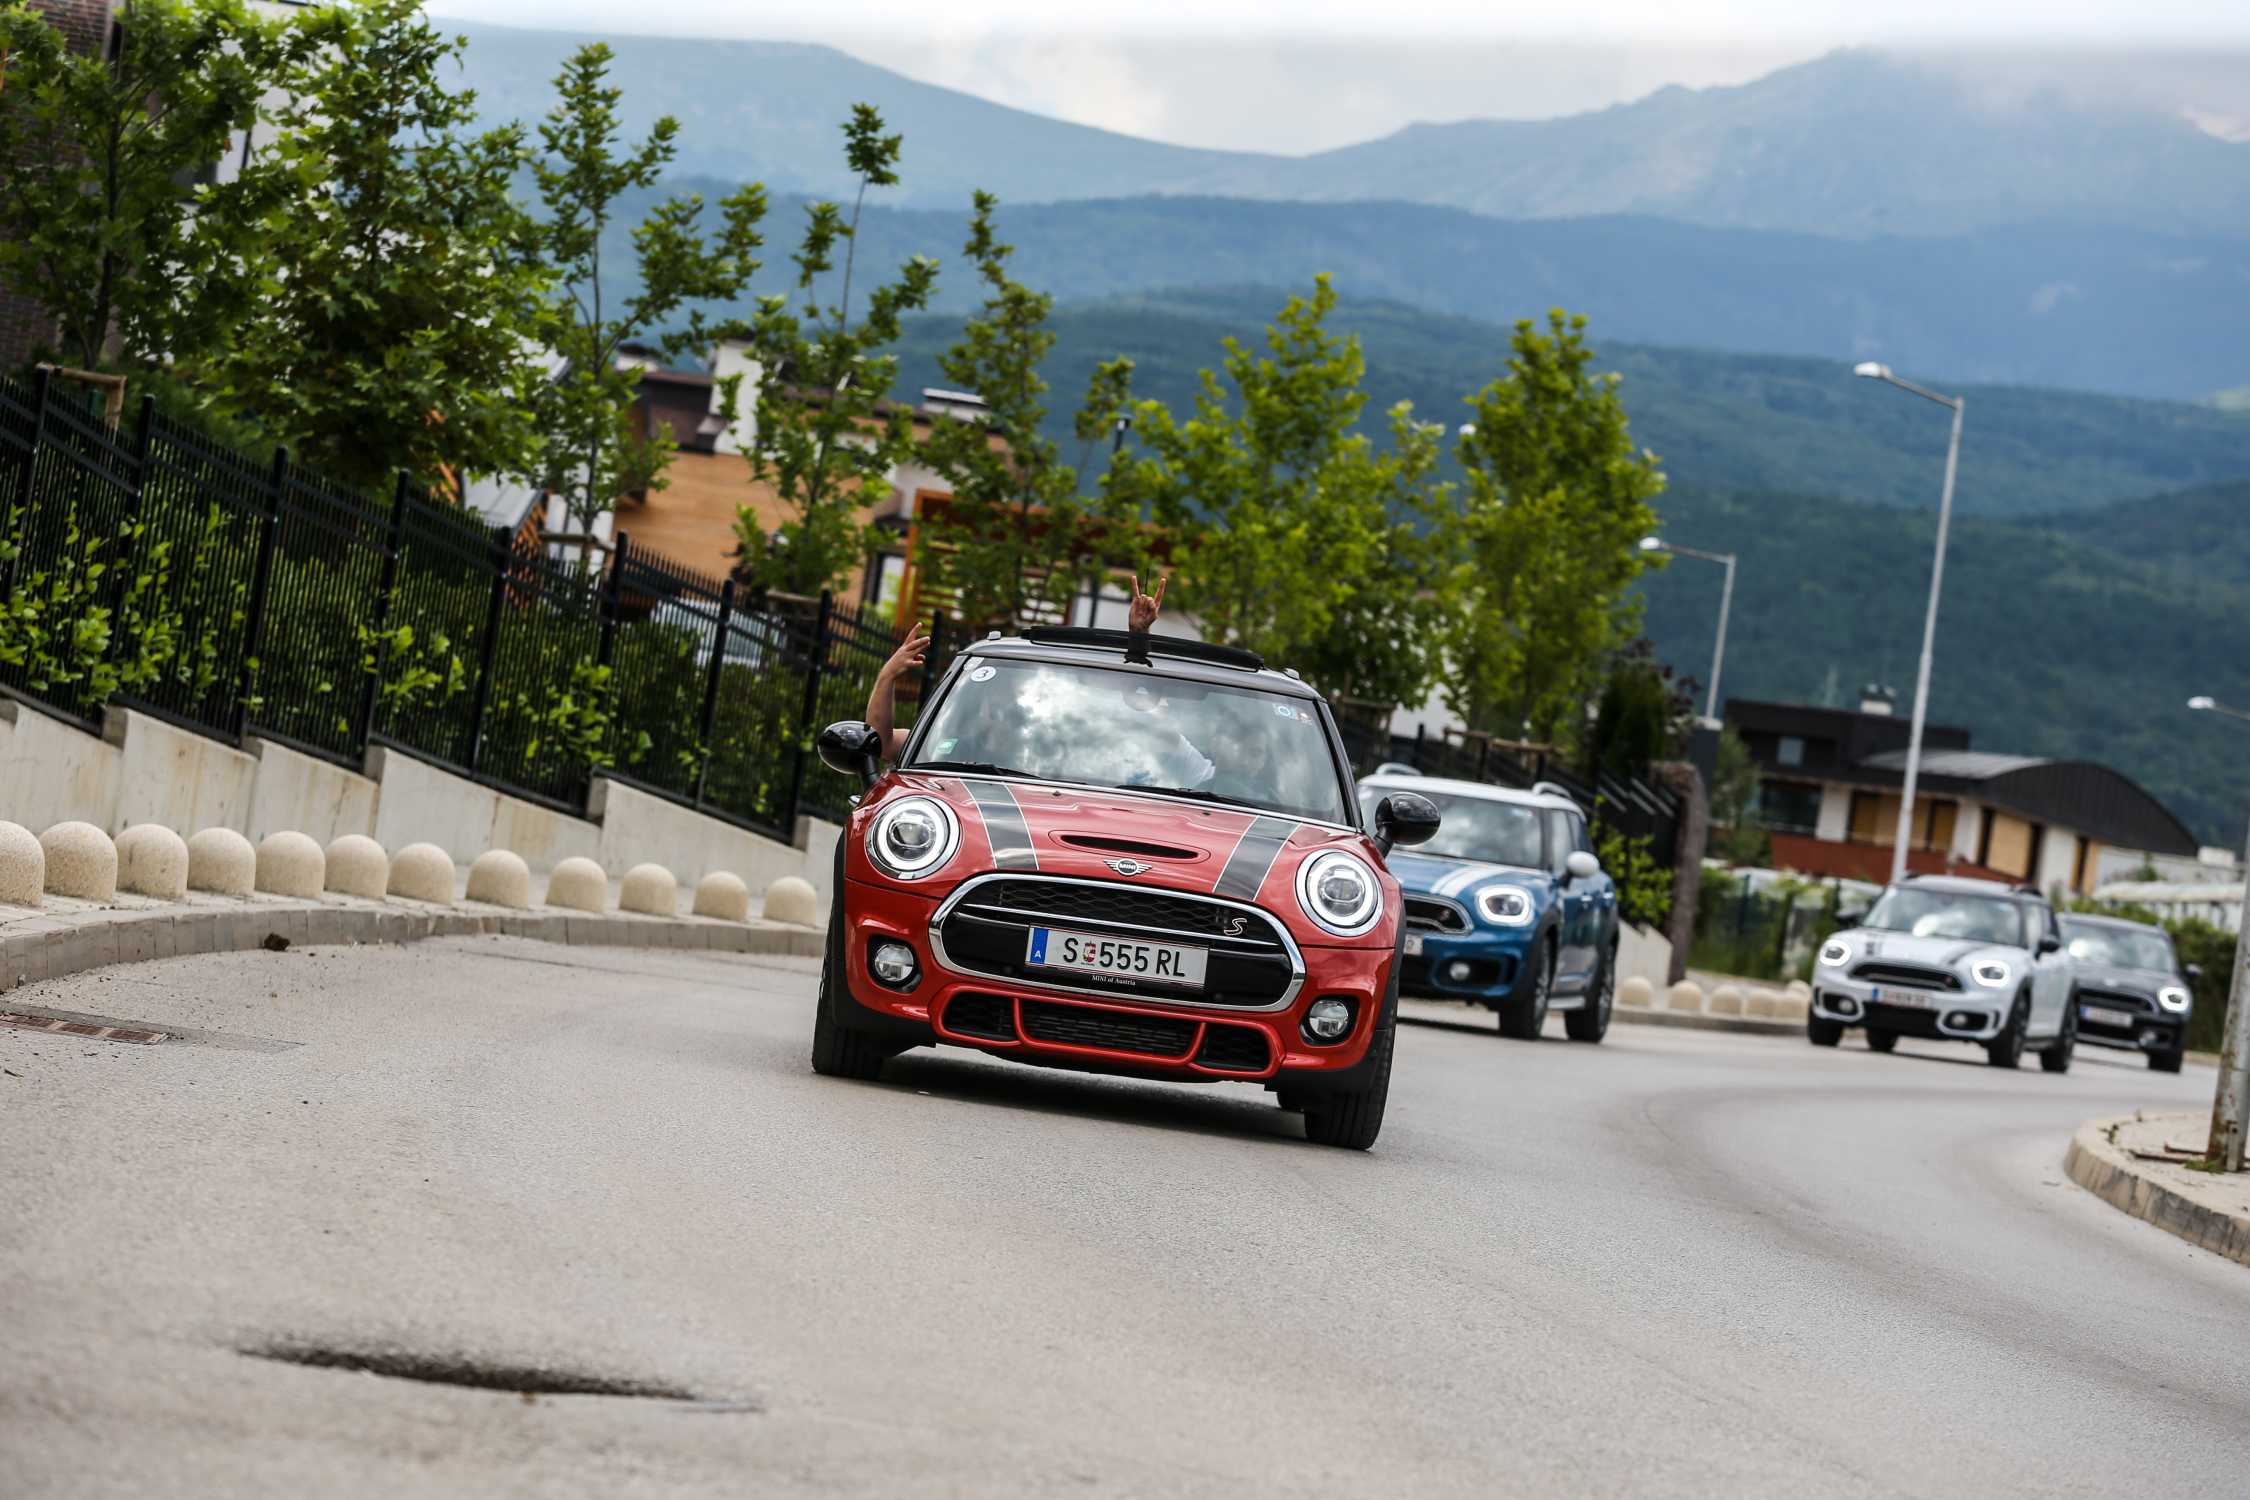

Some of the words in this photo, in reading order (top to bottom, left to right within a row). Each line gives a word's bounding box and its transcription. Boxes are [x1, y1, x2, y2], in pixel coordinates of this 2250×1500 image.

[1118, 862, 1137, 871] MINI
[1223, 917, 1247, 936] S
[1034, 950, 1042, 959] A
[1063, 937, 1079, 963] S
[1099, 941, 1150, 972] 555
[1156, 949, 1186, 977] RL
[1091, 975, 1107, 983] MINI
[1114, 977, 1136, 986] Austria
